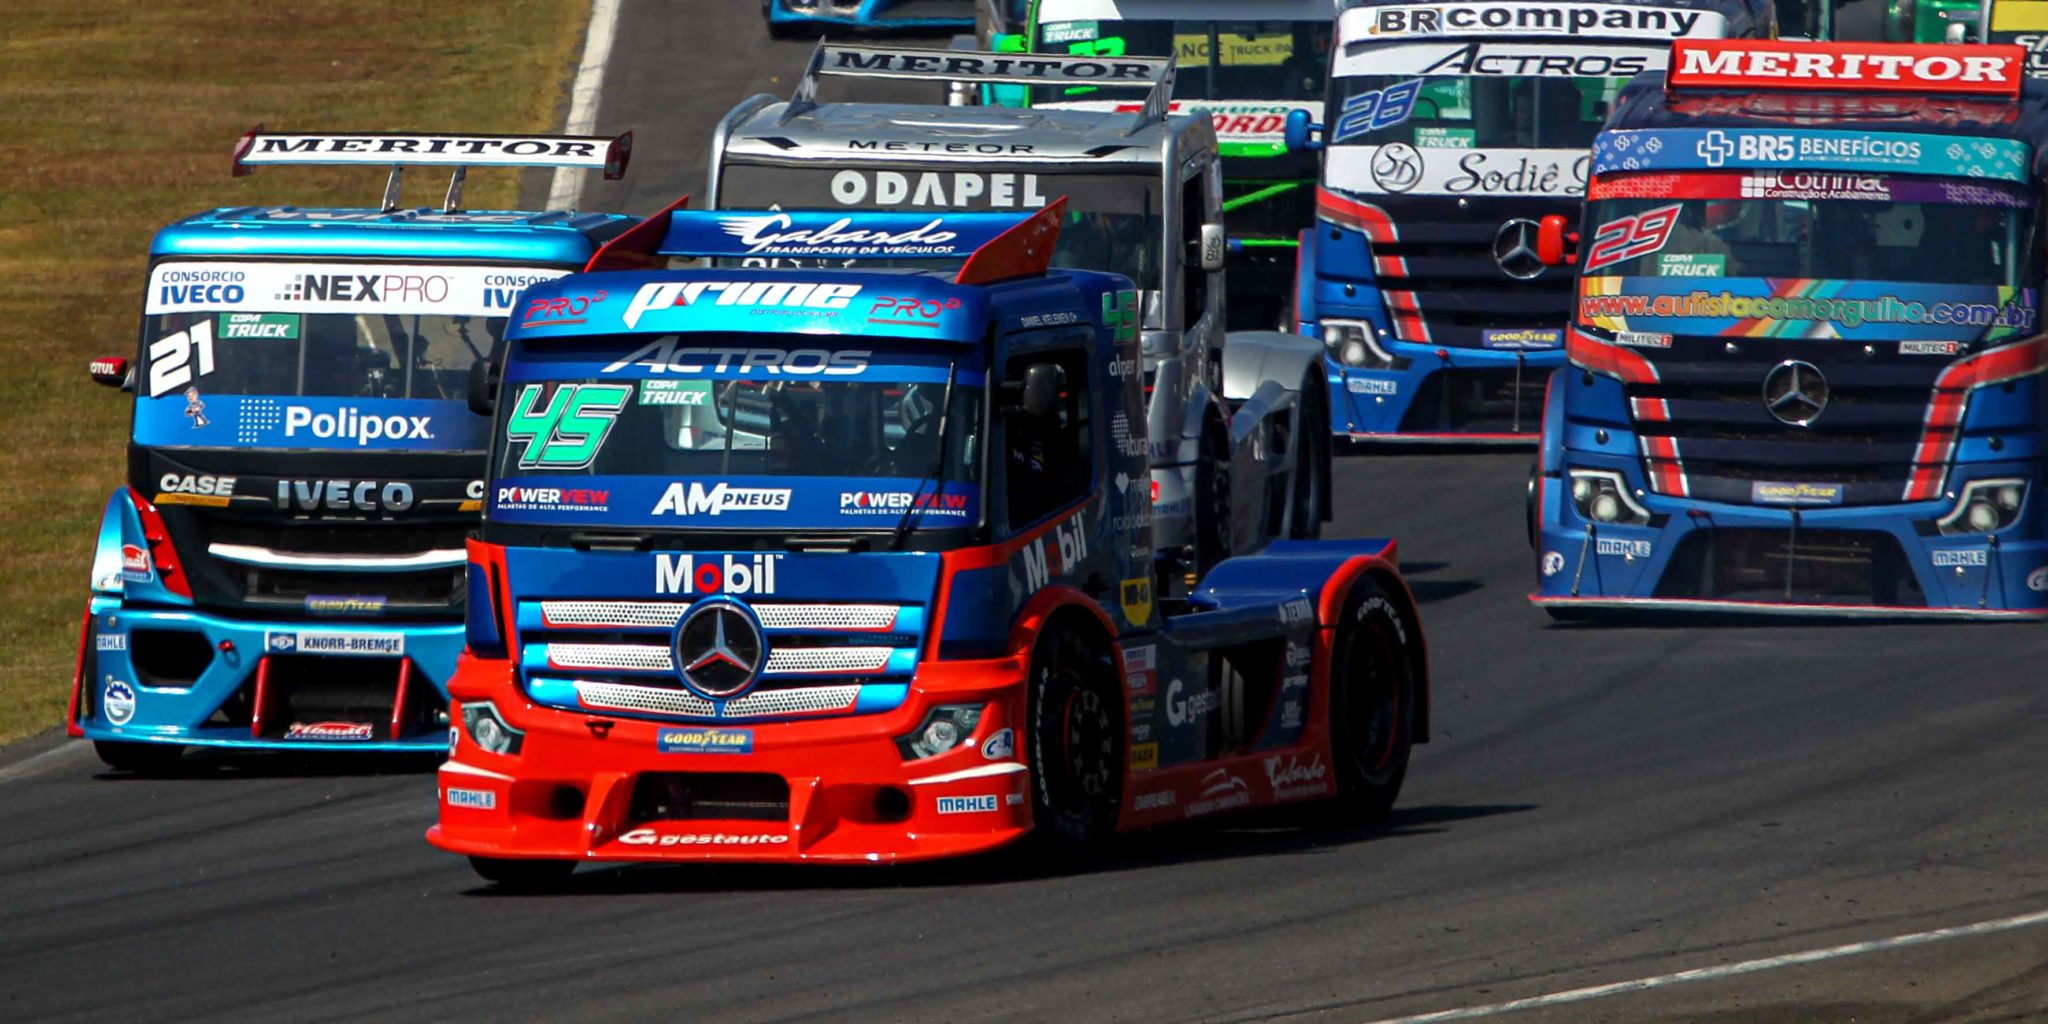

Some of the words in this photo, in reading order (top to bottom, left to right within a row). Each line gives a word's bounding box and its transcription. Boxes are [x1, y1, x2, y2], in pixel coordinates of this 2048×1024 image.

[1045, 28, 1094, 42] TRUCK
[838, 51, 1150, 79] MERITOR
[1419, 42, 1647, 76] ACTROS
[1680, 49, 2006, 82] MERITOR
[1331, 77, 1425, 143] 28
[1213, 115, 1286, 133] ORD
[256, 138, 597, 158] MERITOR
[848, 139, 1034, 154] METEOR
[1416, 136, 1471, 148] TRUCK
[1739, 135, 1794, 161] BR5
[1800, 136, 1922, 159] BENEFÍCIOS
[1444, 152, 1559, 195] Sodiê
[831, 170, 1046, 207] ODAPEL
[738, 213, 957, 254] Gabardo
[1583, 203, 1684, 274] 29
[764, 246, 857, 255] TRANSPORTE
[859, 246, 878, 254] DE
[884, 245, 955, 254] VEÍCULOS
[1663, 254, 1694, 262] COPA
[162, 269, 245, 283] CONSÓRCIO
[1660, 264, 1720, 276] TRUCK
[160, 285, 245, 305] IVECO
[303, 274, 448, 302] NEXPRO
[622, 282, 862, 330] prime
[1581, 291, 2034, 329] www.autistacomorgulho.com.br
[230, 314, 262, 323] COPA
[227, 323, 290, 338] TRUCK
[149, 319, 215, 398] 21
[600, 335, 873, 376] ACTROS
[89, 362, 116, 375] OTUL
[646, 380, 678, 389] COPA
[641, 390, 707, 405] TRUCK
[285, 406, 432, 446] Polipox
[507, 383, 633, 470] 45
[160, 474, 237, 495] CASE
[277, 480, 414, 512] IVECO
[497, 487, 609, 504] POWERVIEW
[722, 492, 785, 505] PNEUS
[911, 509, 966, 517] PEFORMANCE
[1022, 510, 1088, 594] Mobil
[1600, 541, 1650, 556] MAHLE
[1936, 551, 1985, 565] MAHLE
[655, 554, 775, 594] Mobil
[310, 598, 382, 612] GOODYEAR
[304, 637, 400, 651] KNORR-BREMSE
[664, 729, 747, 746] GOODYEAR
[448, 789, 493, 808] MAHLE
[939, 796, 996, 812] MAHLE
[660, 834, 788, 846] gestauto
